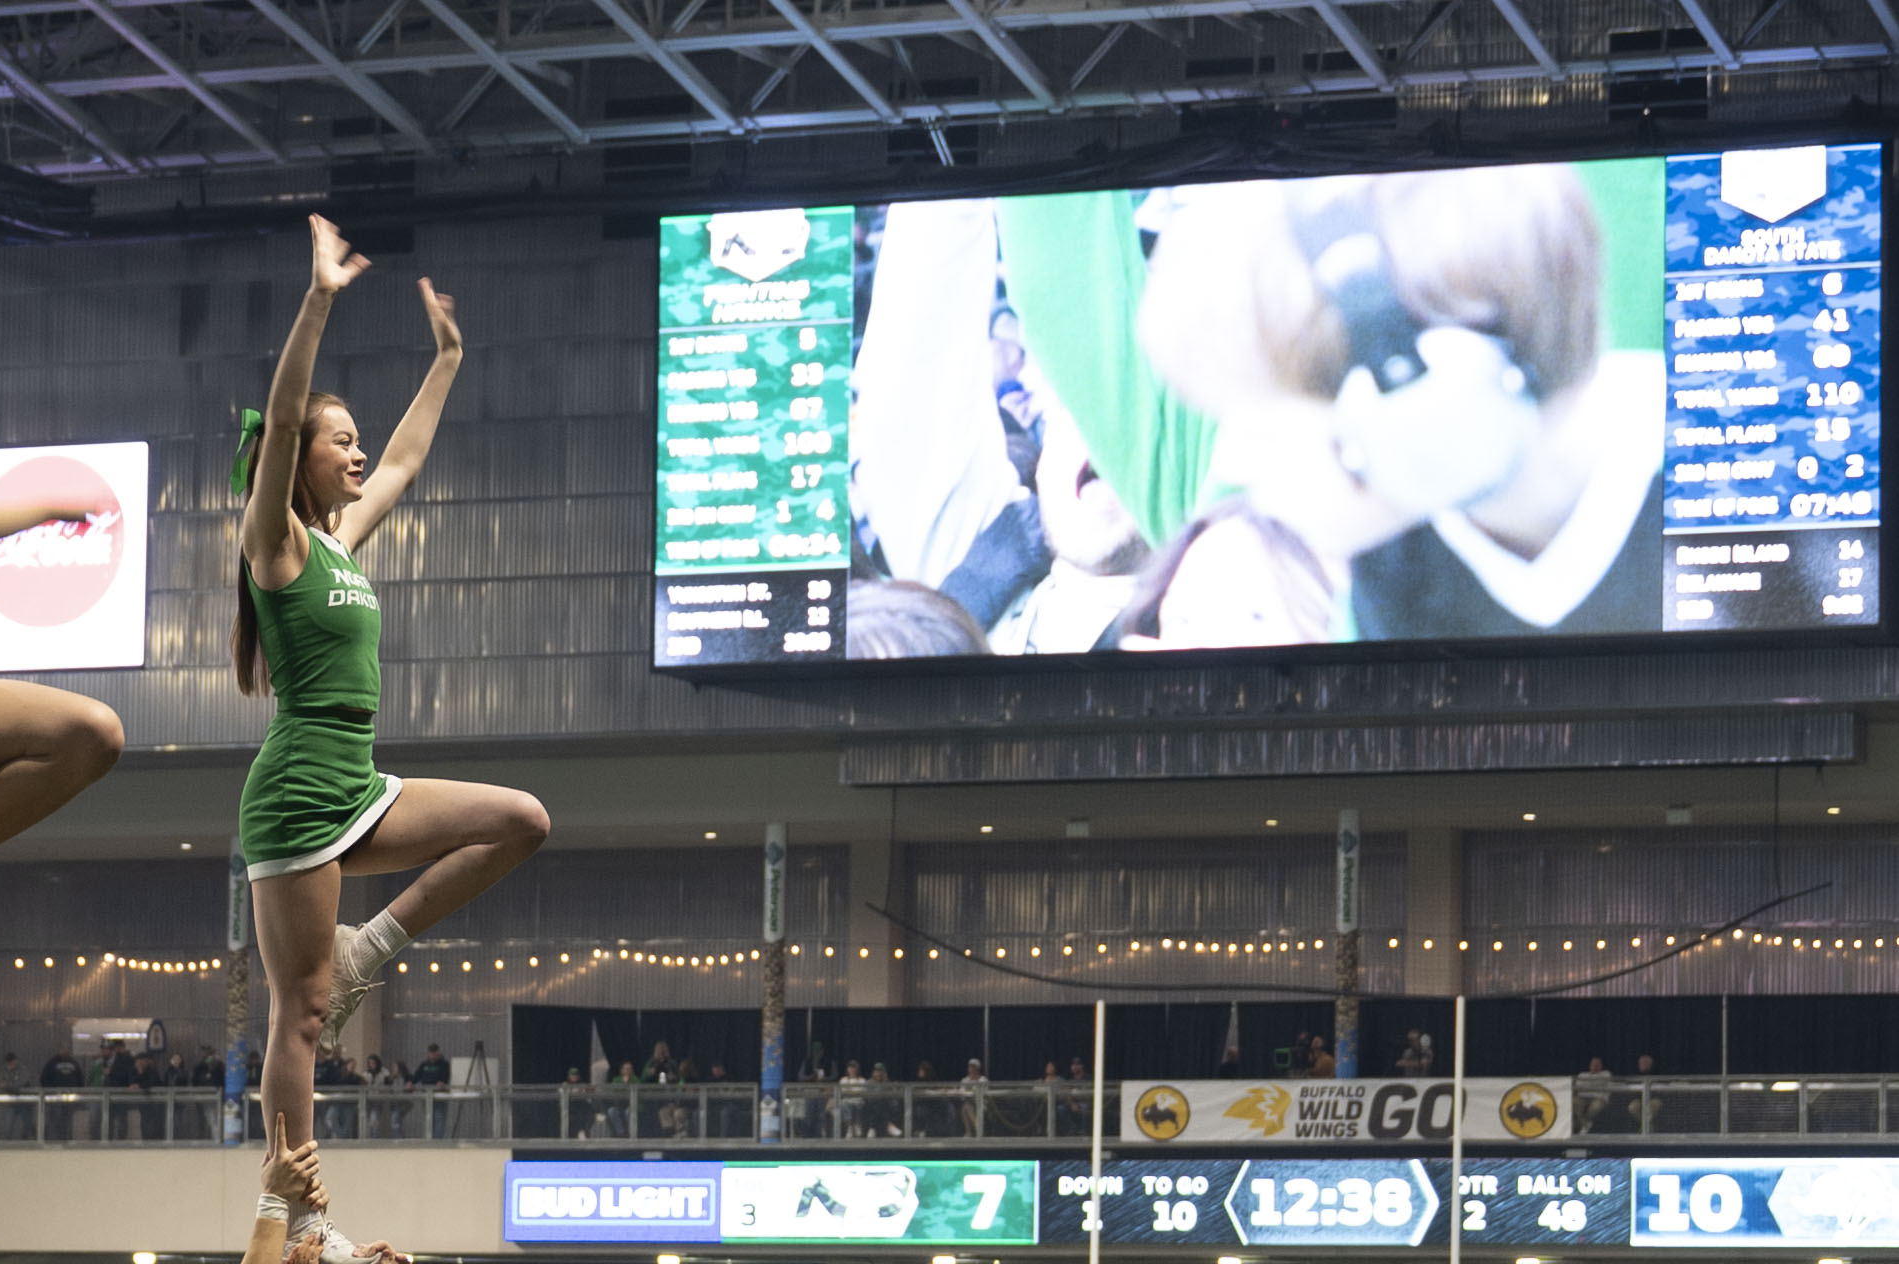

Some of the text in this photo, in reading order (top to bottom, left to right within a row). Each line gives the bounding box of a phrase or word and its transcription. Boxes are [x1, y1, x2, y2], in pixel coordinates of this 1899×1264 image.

[1741, 227, 1805, 246] SOUTH
[1704, 239, 1842, 266] DAKOTA STATE
[1812, 308, 1850, 331] 41
[1806, 381, 1861, 406] 110
[790, 464, 823, 489] 17
[1797, 456, 1818, 479] 0
[1845, 454, 1865, 477] 2
[776, 500, 792, 523] 1
[816, 497, 835, 521] 4
[1300, 1085, 1365, 1098] BUFFALO
[1299, 1101, 1363, 1121] WILD
[1368, 1082, 1467, 1140] GO
[1295, 1122, 1358, 1138] WINGS
[1141, 1175, 1209, 1195] TO GO
[1516, 1174, 1611, 1195] BALL ON
[519, 1186, 708, 1218] BUD LIGHT
[742, 1203, 757, 1226] 3
[962, 1174, 1006, 1230] 7
[1250, 1177, 1413, 1227] 12:38
[1648, 1174, 1744, 1233] 10
[1152, 1200, 1198, 1231] 10
[1462, 1200, 1487, 1231] 2
[1537, 1200, 1588, 1231] 48
